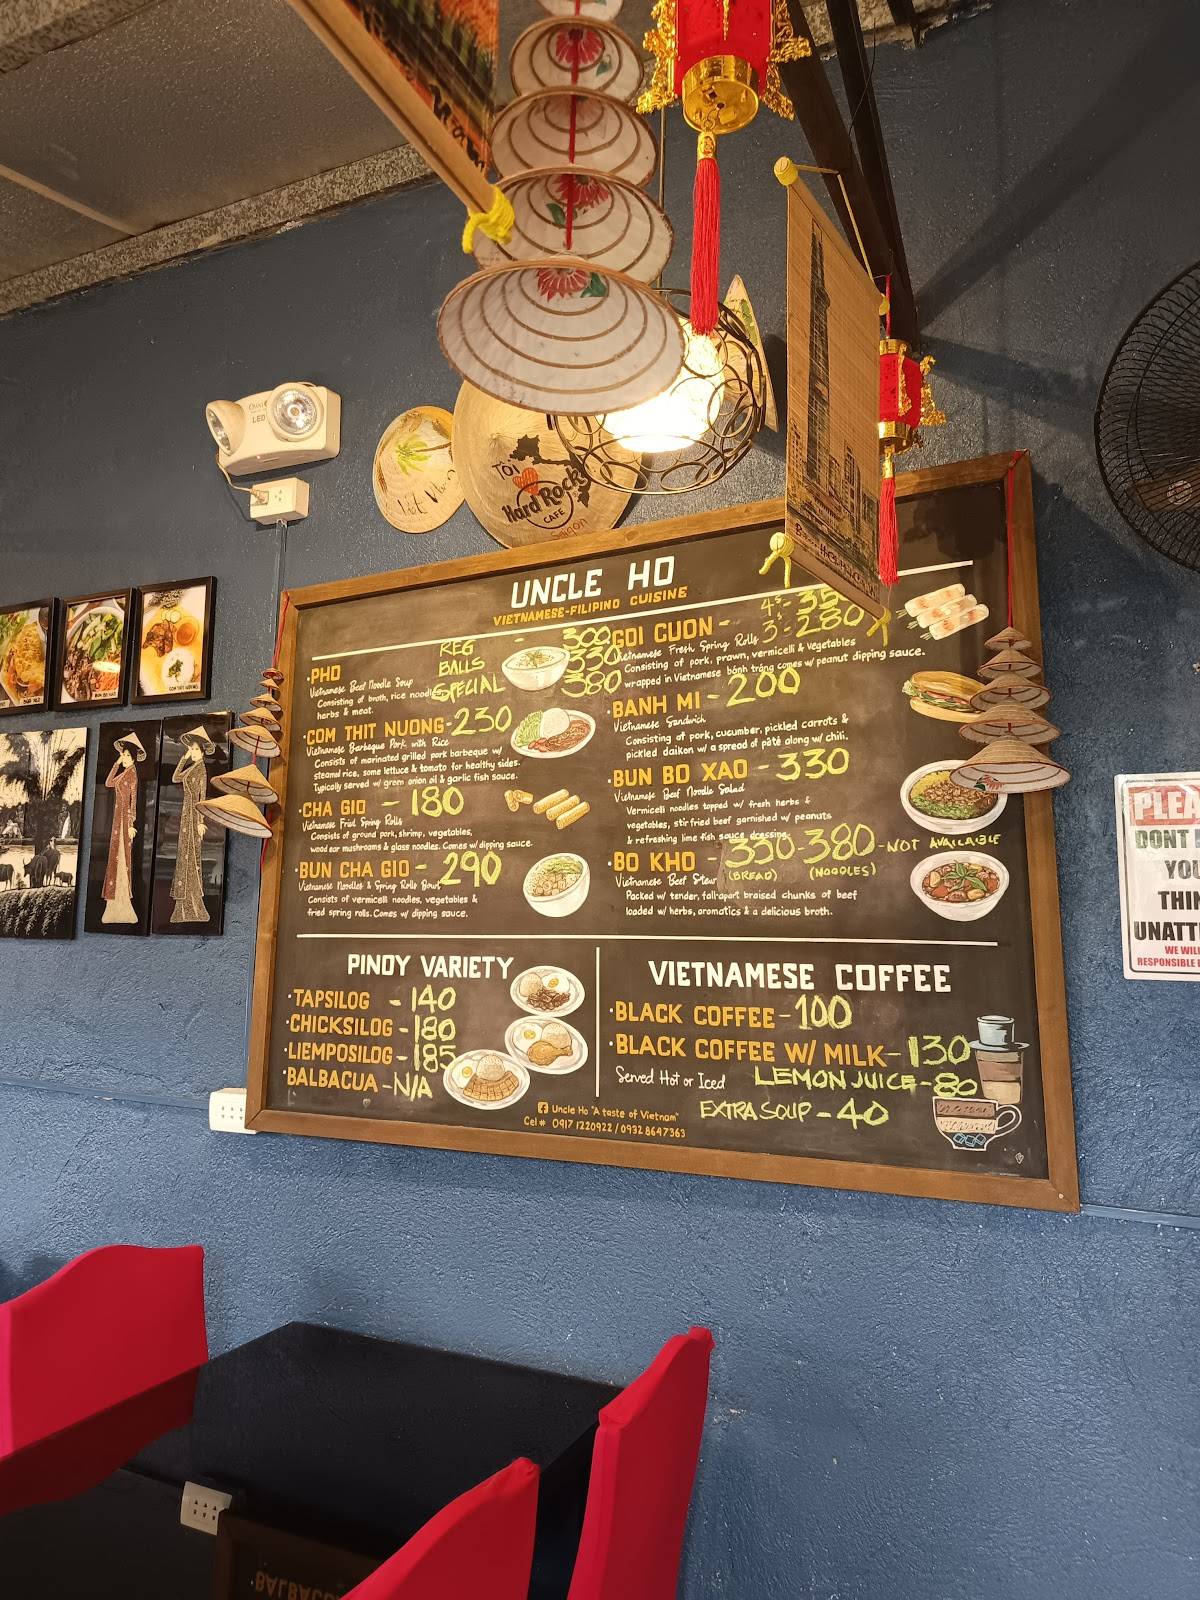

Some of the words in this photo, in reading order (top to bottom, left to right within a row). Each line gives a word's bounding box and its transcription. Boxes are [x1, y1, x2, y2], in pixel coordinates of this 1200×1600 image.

[502, 494, 541, 523] Hard
[539, 466, 588, 507] Rock
[543, 507, 566, 524] CAFE
[511, 568, 603, 609] UNCLE
[627, 555, 675, 591] HO
[493, 598, 621, 627] VIETNAMESE-FILIPINO
[630, 586, 689, 606] CUISINE
[795, 604, 865, 638] 280
[440, 640, 476, 657] REG
[562, 626, 611, 650] 300
[612, 626, 644, 649] GOI
[654, 616, 713, 643] CUON
[438, 656, 486, 677] BALLS
[569, 644, 621, 673] 330
[624, 660, 669, 673] Consisting
[674, 657, 684, 667] of
[716, 652, 750, 665] prawn,
[752, 644, 795, 658] vermicelli
[798, 643, 804, 652] &
[807, 638, 856, 653] vegetables
[310, 685, 346, 698] Vietnamese
[349, 680, 367, 693] Beef
[368, 678, 391, 690] Noodle
[395, 677, 414, 688] Soup
[311, 664, 341, 684] PHO
[431, 673, 506, 703] SPECIAL
[561, 669, 622, 697] 380
[726, 668, 800, 707] 200
[613, 695, 667, 718] BANH
[677, 691, 701, 712] MI
[306, 727, 337, 745] COM
[345, 722, 377, 741] THIT
[384, 717, 445, 738] NUONG
[451, 705, 513, 736] 230
[626, 733, 672, 746] Consisting
[676, 731, 686, 741] of
[715, 726, 763, 738] cucumber,
[764, 720, 798, 735] pickled
[801, 715, 838, 728] carrots
[841, 712, 849, 724] &
[315, 757, 346, 768] Consists
[350, 756, 358, 765] of
[361, 753, 399, 765] marinated
[402, 751, 426, 762] grilled
[431, 751, 447, 760] pork
[450, 747, 488, 758] barbeque
[492, 746, 503, 756] w/
[775, 747, 850, 781] 330
[613, 767, 652, 788] BUN
[662, 763, 690, 785] BO
[701, 758, 748, 782] XAO
[302, 800, 333, 817] CHA
[340, 799, 366, 815] GIO
[411, 785, 464, 817] 180
[302, 819, 336, 832] Vietnamese
[360, 816, 381, 829] Spring
[384, 813, 403, 825] Rolls
[626, 821, 671, 832] vegetables,
[713, 816, 732, 826] beef
[736, 813, 777, 826] garnished
[780, 813, 791, 822] w/
[794, 812, 832, 824] peanuts
[1135, 829, 1189, 849] DONT
[299, 861, 332, 879] BUN
[340, 861, 374, 878] CHA
[381, 859, 410, 878] GIO
[440, 850, 502, 888] 290
[613, 851, 639, 872] BO
[651, 851, 696, 872] KHO
[615, 873, 662, 887] Vietnamese
[667, 873, 687, 886] Beef
[692, 873, 718, 886] Stew
[308, 895, 338, 904] Consists
[341, 895, 350, 904] of
[352, 894, 388, 904] vermicelli
[392, 895, 422, 904] noodles,
[425, 895, 468, 906] vegetables
[472, 894, 478, 904] &
[626, 905, 654, 916] loaded
[657, 906, 667, 916] w/
[669, 906, 696, 917] herbs,
[698, 905, 741, 916] aromatics
[744, 905, 749, 915] &
[761, 906, 801, 916] delicious
[804, 906, 833, 916] broth.
[1137, 957, 1195, 967] RESPONSIBLE
[1165, 946, 1179, 955] WE
[347, 954, 411, 976] PINOY
[420, 955, 514, 979] VARIETY
[648, 960, 815, 990] VIETNAMESE
[835, 963, 952, 993] COFFEE
[293, 989, 370, 1010] TAPSILOG
[411, 983, 457, 1013] 140
[794, 993, 853, 1031] 100
[290, 1013, 393, 1037] CHICKSILOG
[414, 1014, 456, 1043] 180
[615, 1000, 683, 1024] BLACK
[693, 1005, 775, 1029] COFFEE
[288, 1042, 393, 1065] LIEMPOSILOG
[413, 1043, 457, 1073] 185
[615, 1033, 687, 1058] BLACK
[694, 1038, 775, 1063] COFFEE
[783, 1039, 817, 1066] W/
[824, 1042, 888, 1068] MILK
[908, 1034, 971, 1068] 130
[287, 1066, 379, 1093] BALBACUA
[393, 1071, 433, 1102] N/A
[615, 1065, 655, 1085] Served
[659, 1070, 681, 1086] Hot
[683, 1077, 694, 1087] or
[698, 1072, 726, 1091] Iced
[754, 1065, 847, 1090] LEMON
[851, 1072, 917, 1091] JUICE
[933, 1072, 978, 1099] 80
[552, 1104, 576, 1115] Uncle
[578, 1106, 589, 1116] Ho
[602, 1108, 626, 1119] taste
[628, 1109, 638, 1120] of
[552, 1118, 574, 1130] 0917
[620, 1122, 643, 1135] 0932
[700, 1100, 757, 1121] EXTRA
[760, 1100, 813, 1123] SOUP
[836, 1097, 890, 1130] 40
